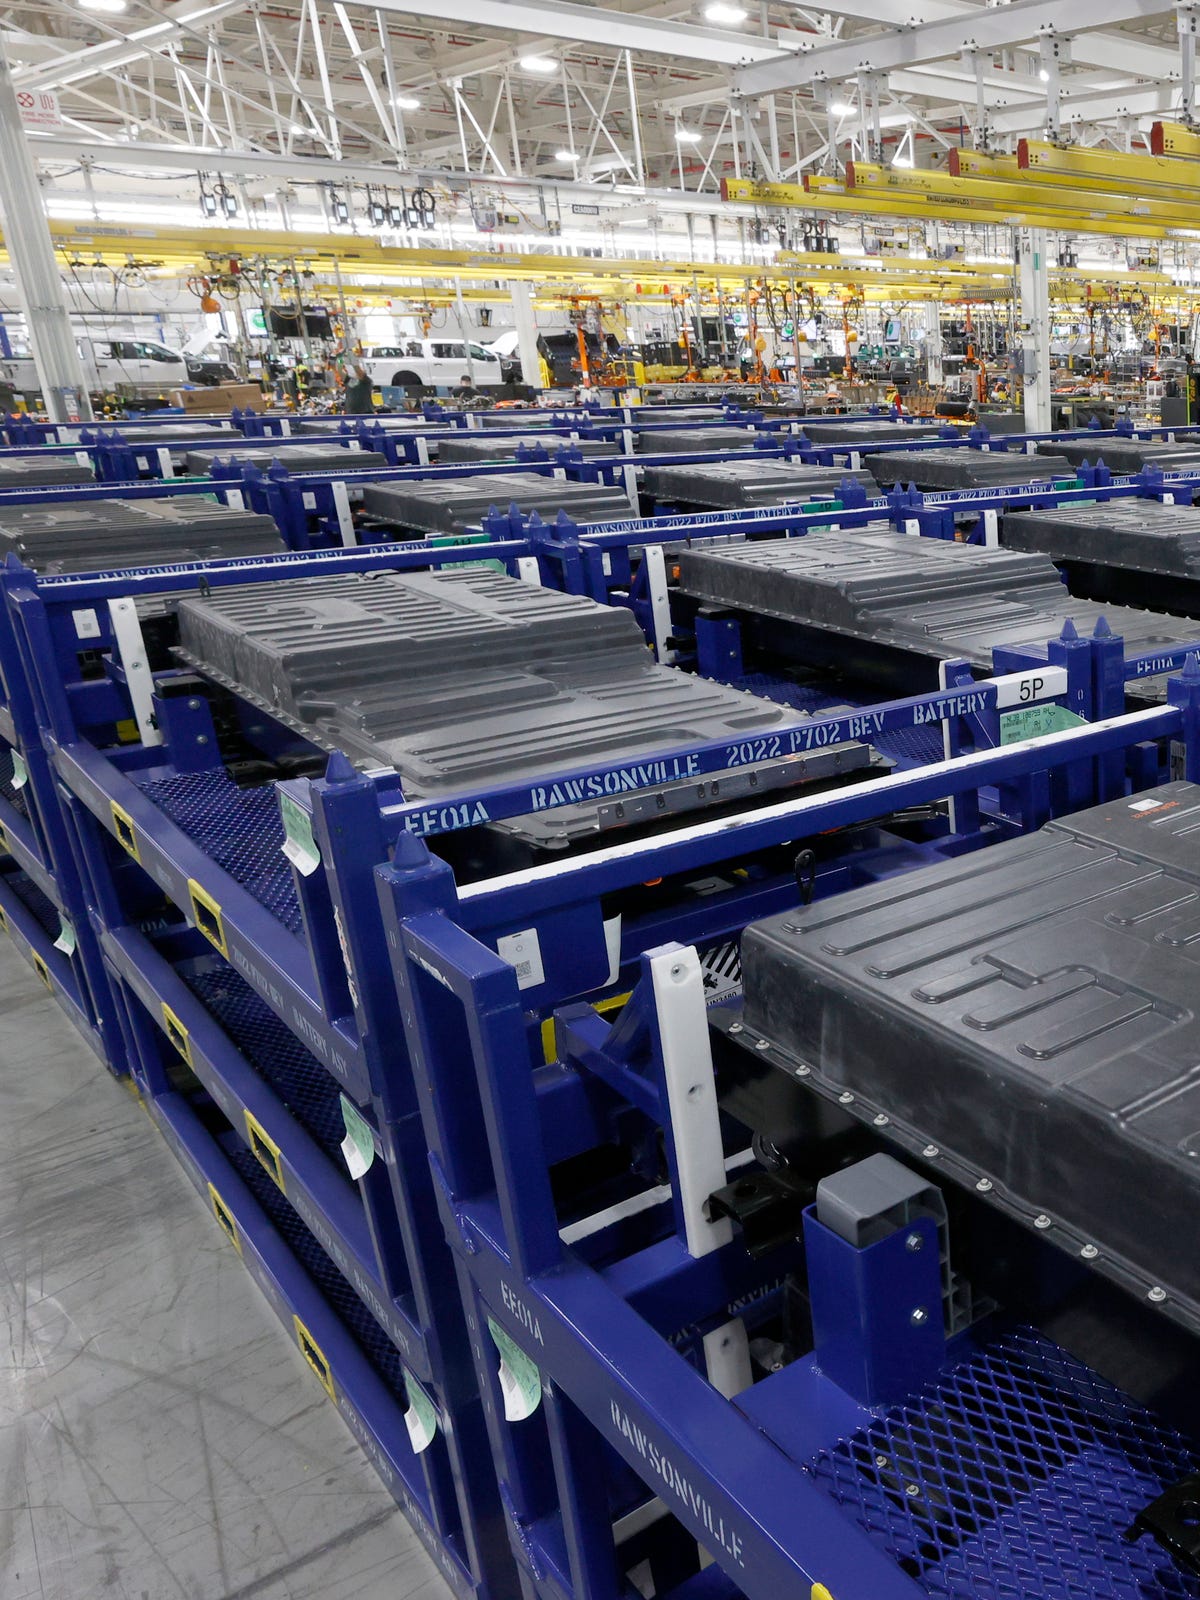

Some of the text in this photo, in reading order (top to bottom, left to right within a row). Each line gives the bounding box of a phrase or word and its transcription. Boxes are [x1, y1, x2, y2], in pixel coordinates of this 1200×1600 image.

[958, 490, 977, 500] 2022
[978, 489, 996, 499] P702
[998, 488, 1012, 497] BEV
[1018, 484, 1048, 495] BATTERY
[586, 518, 659, 535] RAWSONVILLE
[665, 516, 692, 529] 2022
[695, 513, 720, 525] P702
[723, 511, 742, 523] BEV
[753, 506, 793, 519] BATTERY
[1019, 677, 1044, 701] 5P
[530, 751, 701, 812] RAWSONVILLE
[726, 736, 783, 768] 2022
[789, 721, 842, 752] P702
[848, 711, 887, 738] BEV
[913, 691, 989, 726] BATTERY
[610, 1399, 745, 1569] RAWSONVILLE
